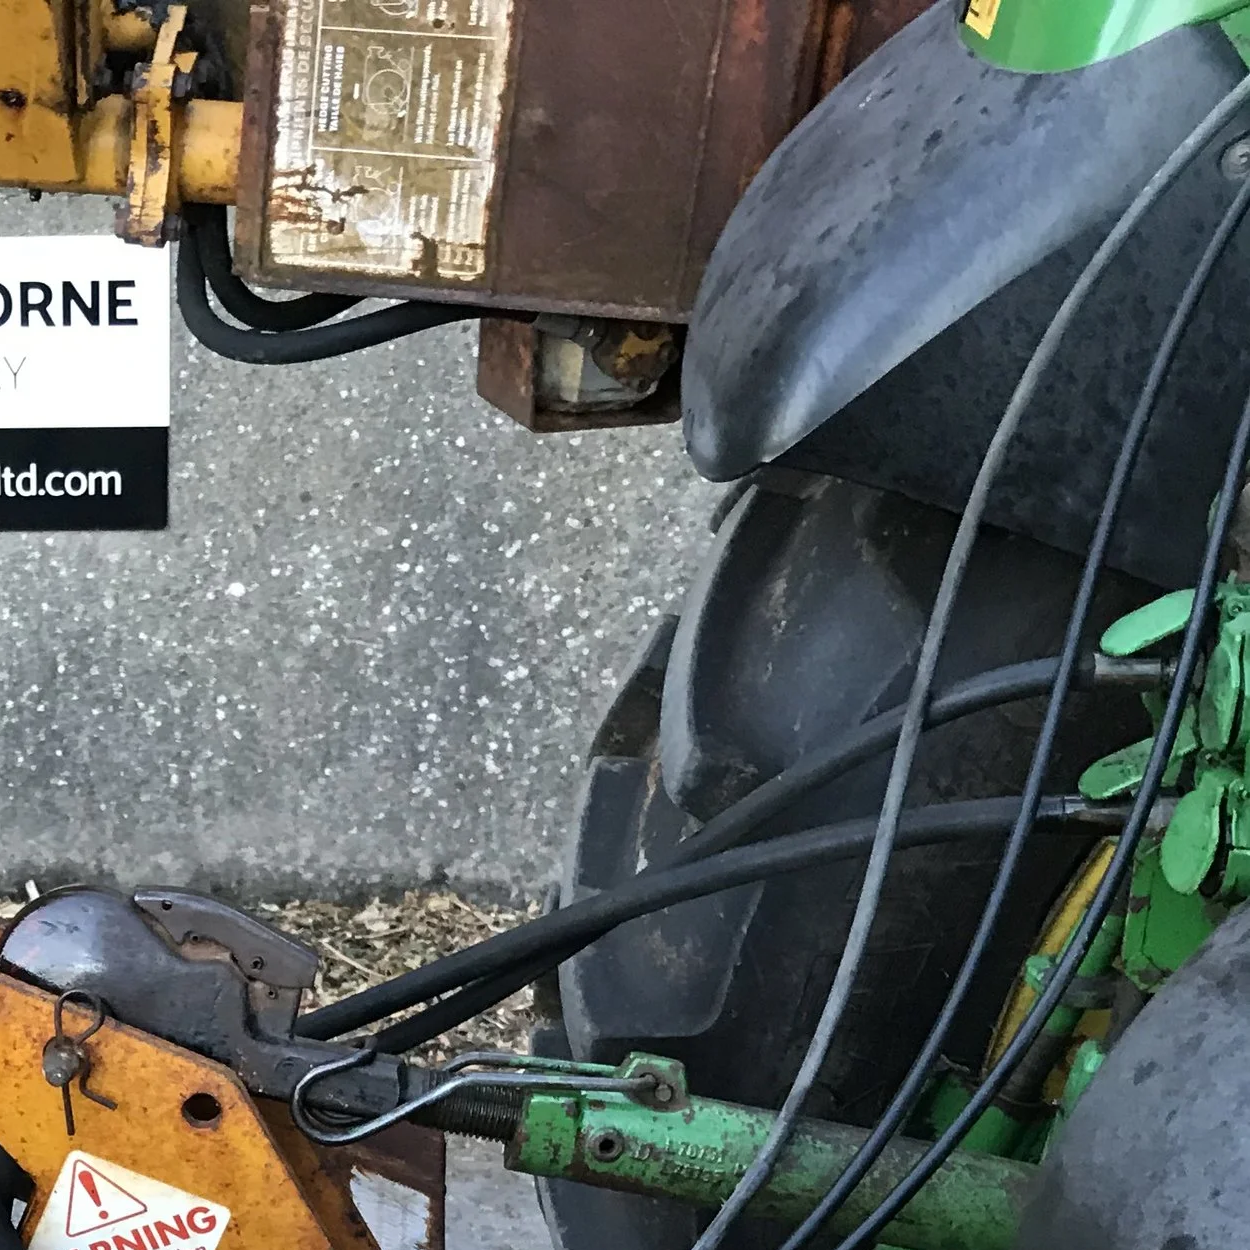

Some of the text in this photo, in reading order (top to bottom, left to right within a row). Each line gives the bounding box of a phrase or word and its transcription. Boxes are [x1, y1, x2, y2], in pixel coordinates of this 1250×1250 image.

[318, 45, 333, 132] HEDGE CUTTING
[333, 82, 343, 96] DE
